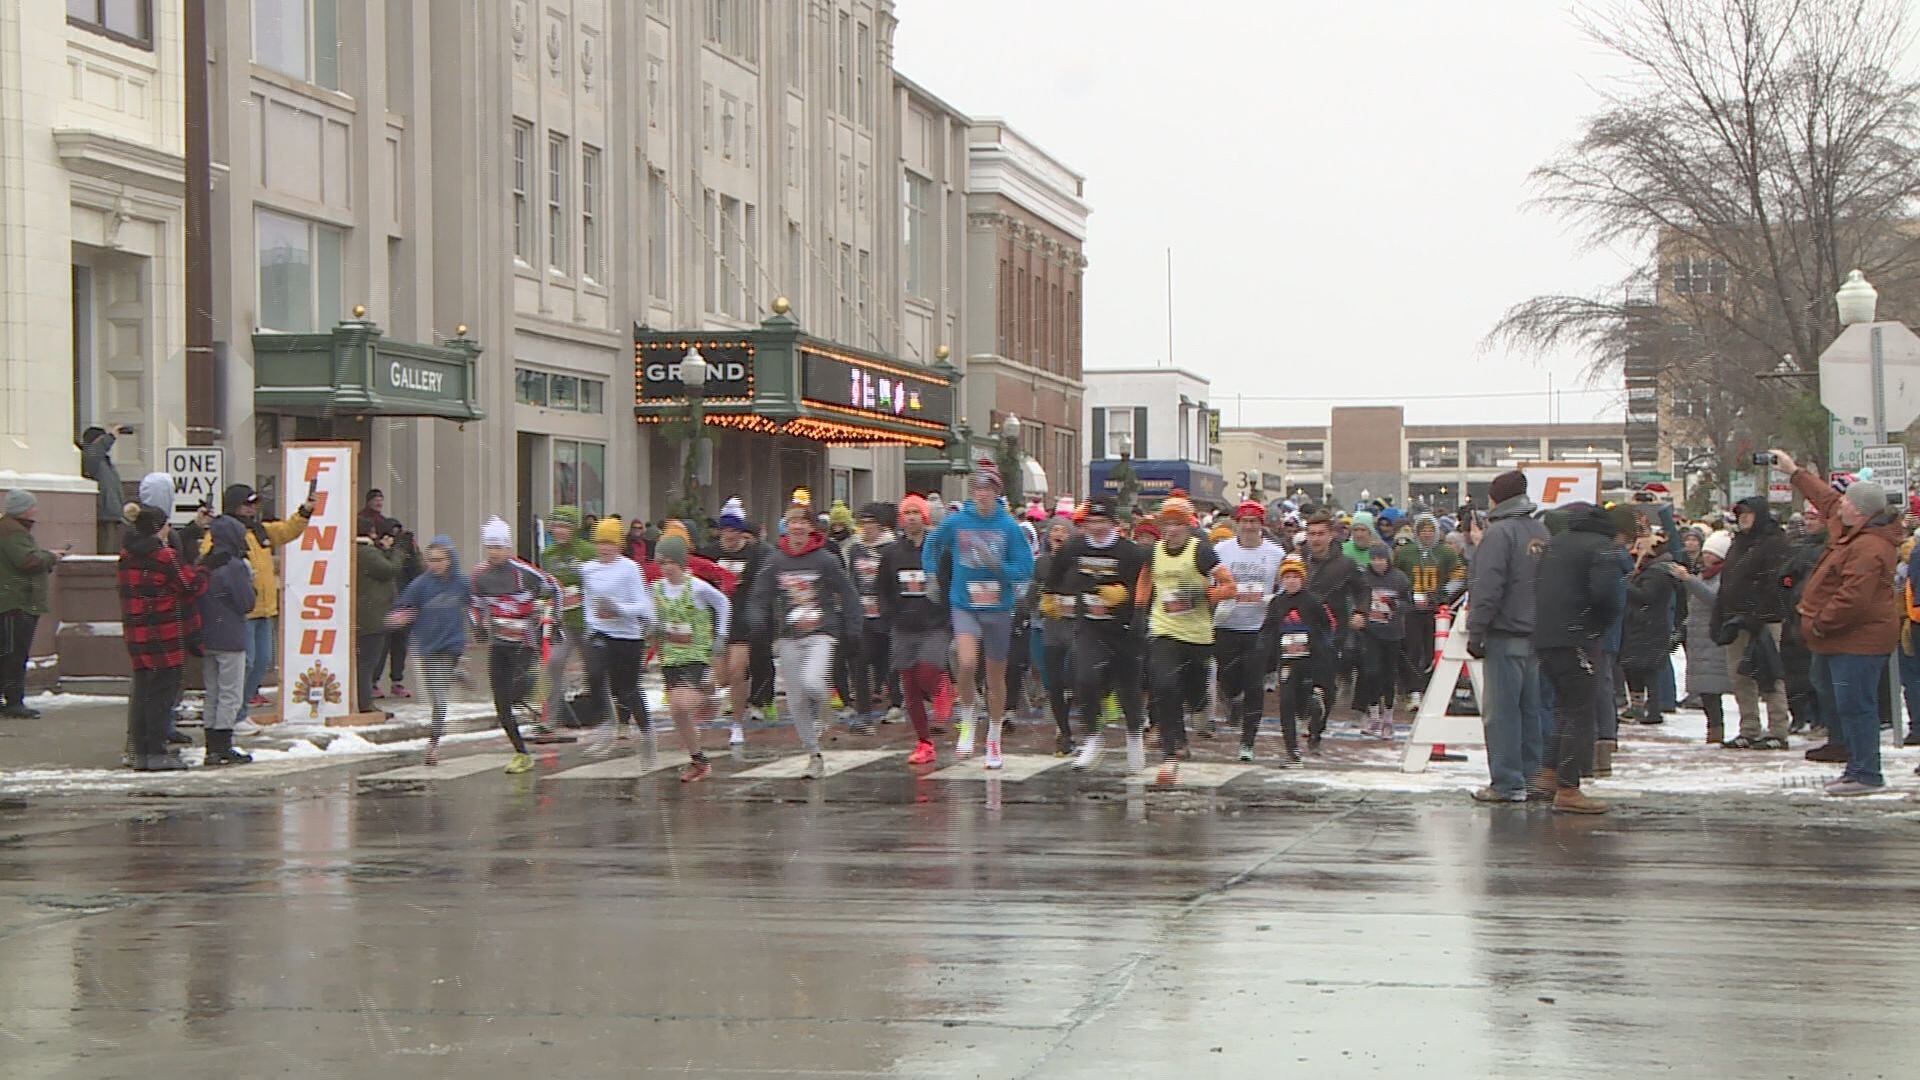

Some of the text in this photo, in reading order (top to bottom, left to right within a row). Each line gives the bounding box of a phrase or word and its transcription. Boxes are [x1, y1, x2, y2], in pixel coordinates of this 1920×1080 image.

[390, 361, 443, 393] GALLERY
[646, 362, 745, 381] GRND
[174, 454, 217, 472] ONE
[1865, 451, 1902, 459] ALCOHOLIC
[173, 476, 218, 494] WAY
[1541, 477, 1580, 503] F
[300, 456, 337, 654] FINISH
